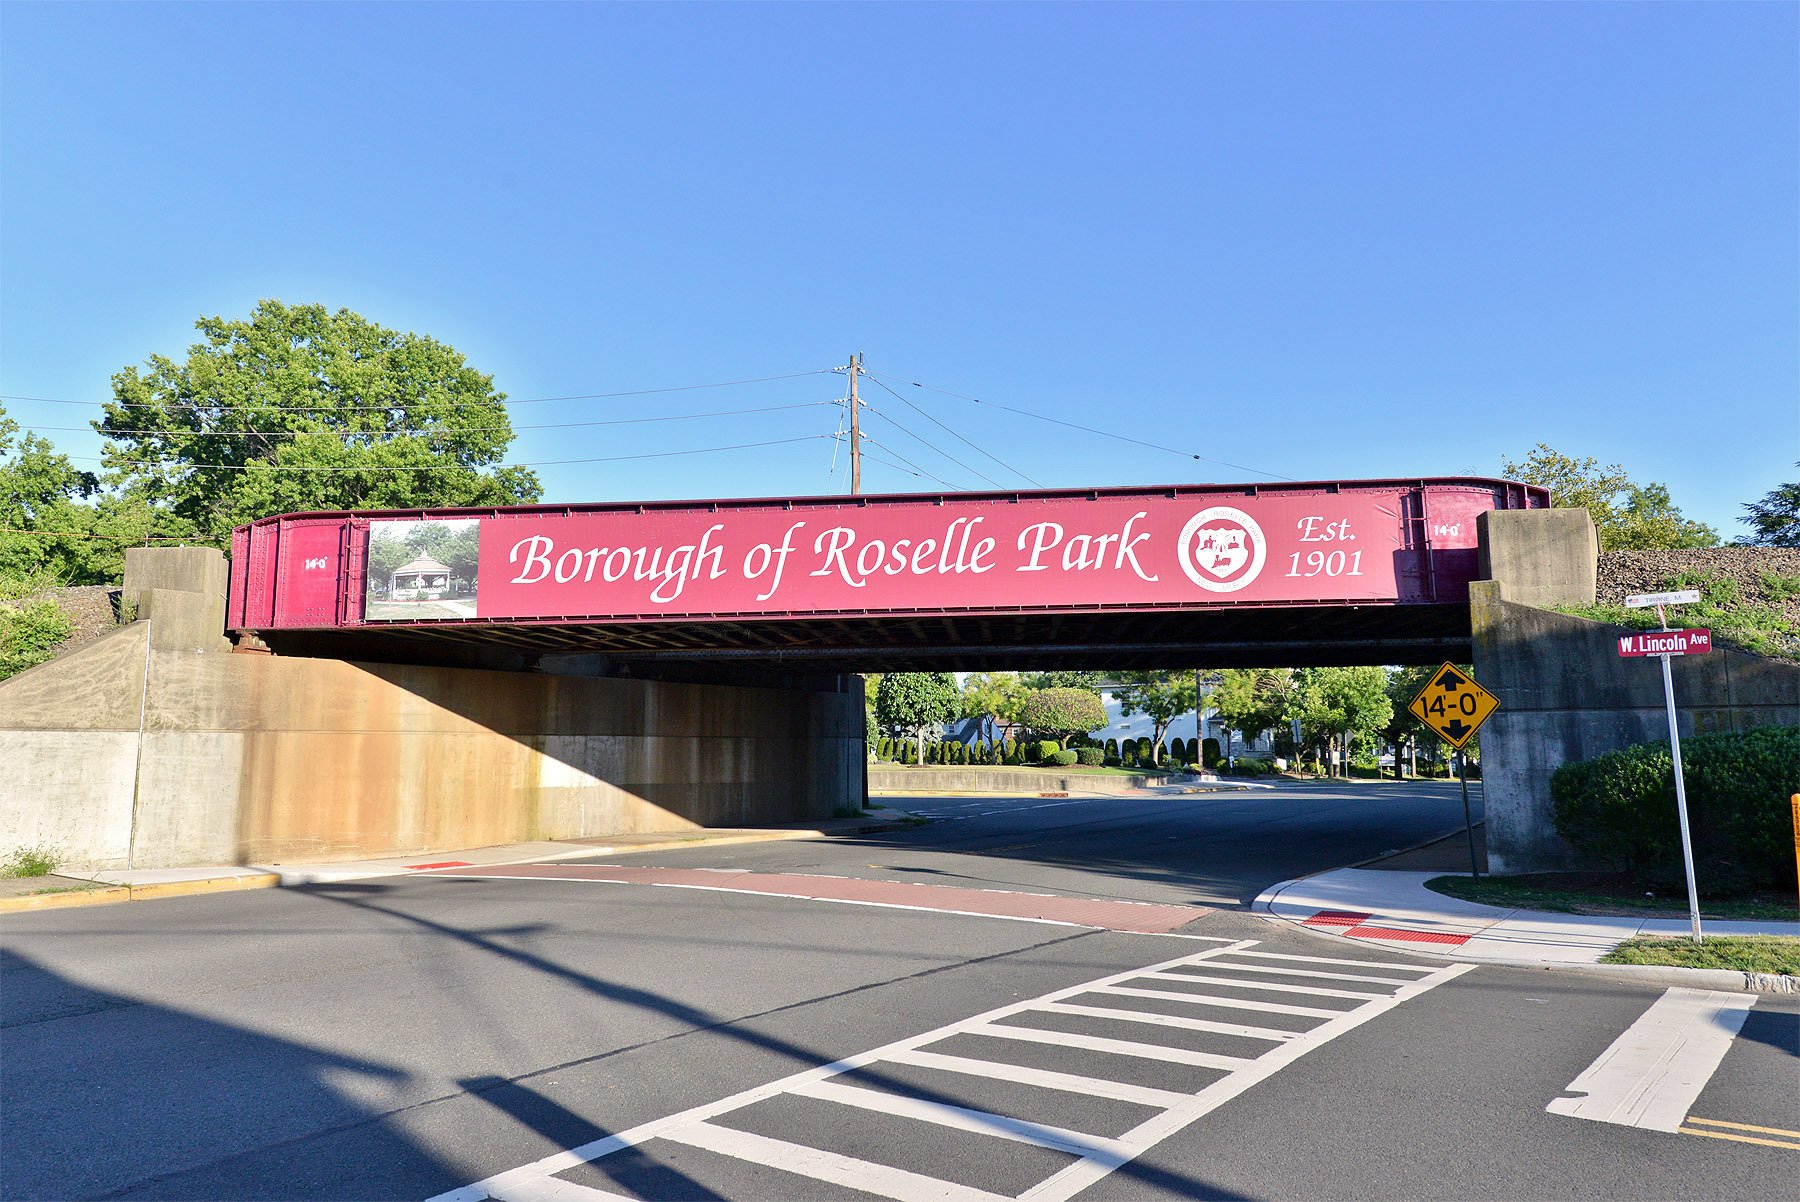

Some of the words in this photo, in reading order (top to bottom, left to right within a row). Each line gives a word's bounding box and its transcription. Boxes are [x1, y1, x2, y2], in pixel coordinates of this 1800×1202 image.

[1297, 515, 1356, 542] Est.
[509, 524, 728, 604] Borough
[744, 521, 806, 603] of
[809, 515, 996, 589] Roselle
[1015, 511, 1159, 585] Park
[1284, 549, 1364, 577] 1901
[1620, 636, 1637, 653] W.
[1639, 634, 1687, 652] Lincoln
[1690, 633, 1708, 645] Ave
[1421, 691, 1483, 719] 14'-0"
